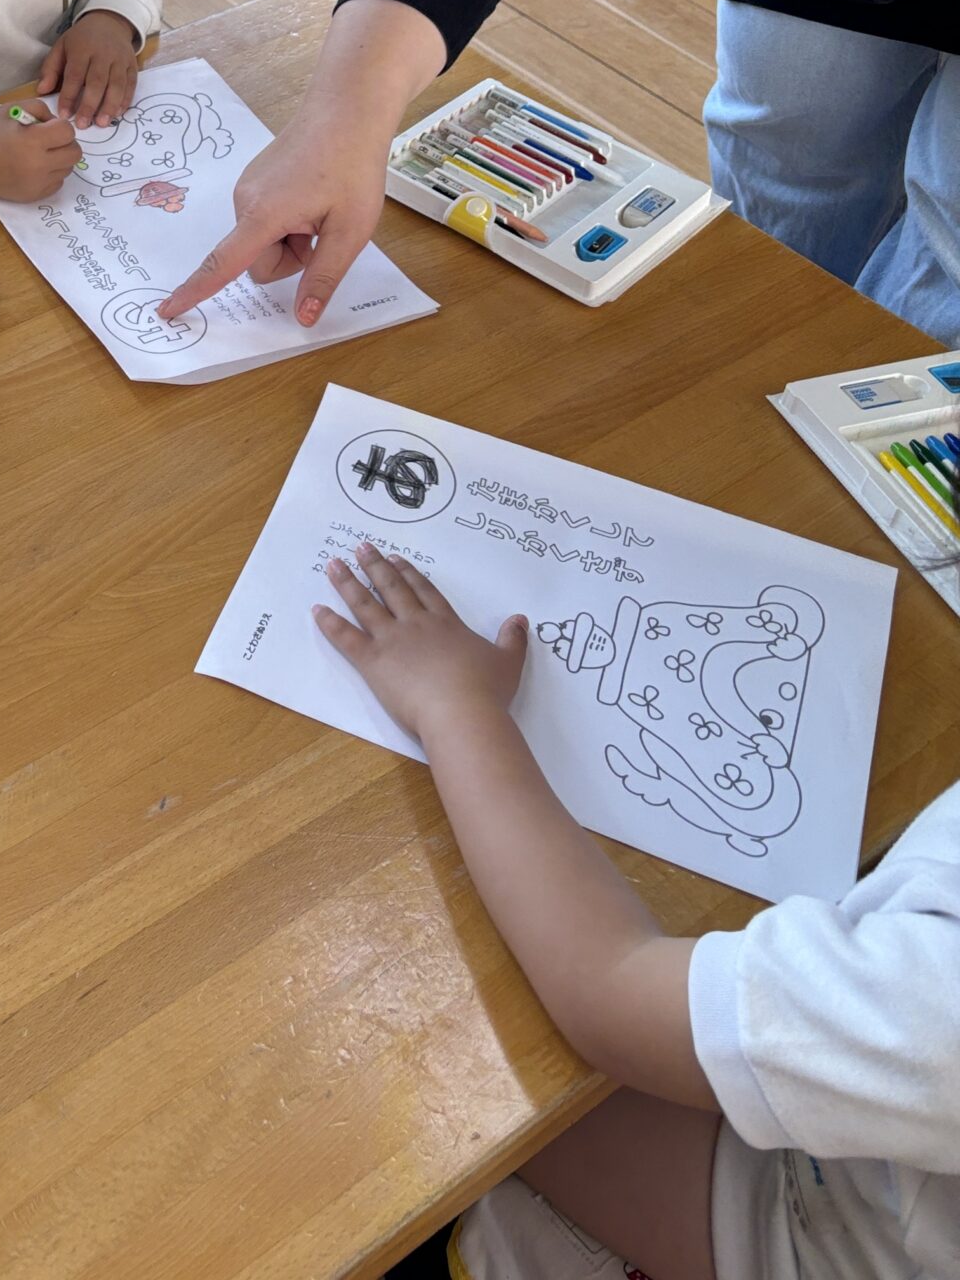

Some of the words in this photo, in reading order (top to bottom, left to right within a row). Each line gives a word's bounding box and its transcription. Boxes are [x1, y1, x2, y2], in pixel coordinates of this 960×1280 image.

[37, 204, 118, 292] たまかくして
[73, 194, 150, 281] しりかくさず
[351, 442, 440, 510] あ
[464, 476, 655, 549] たまかくして
[454, 510, 646, 585] しりかくさず
[242, 611, 274, 662] ことわざぬりえ
